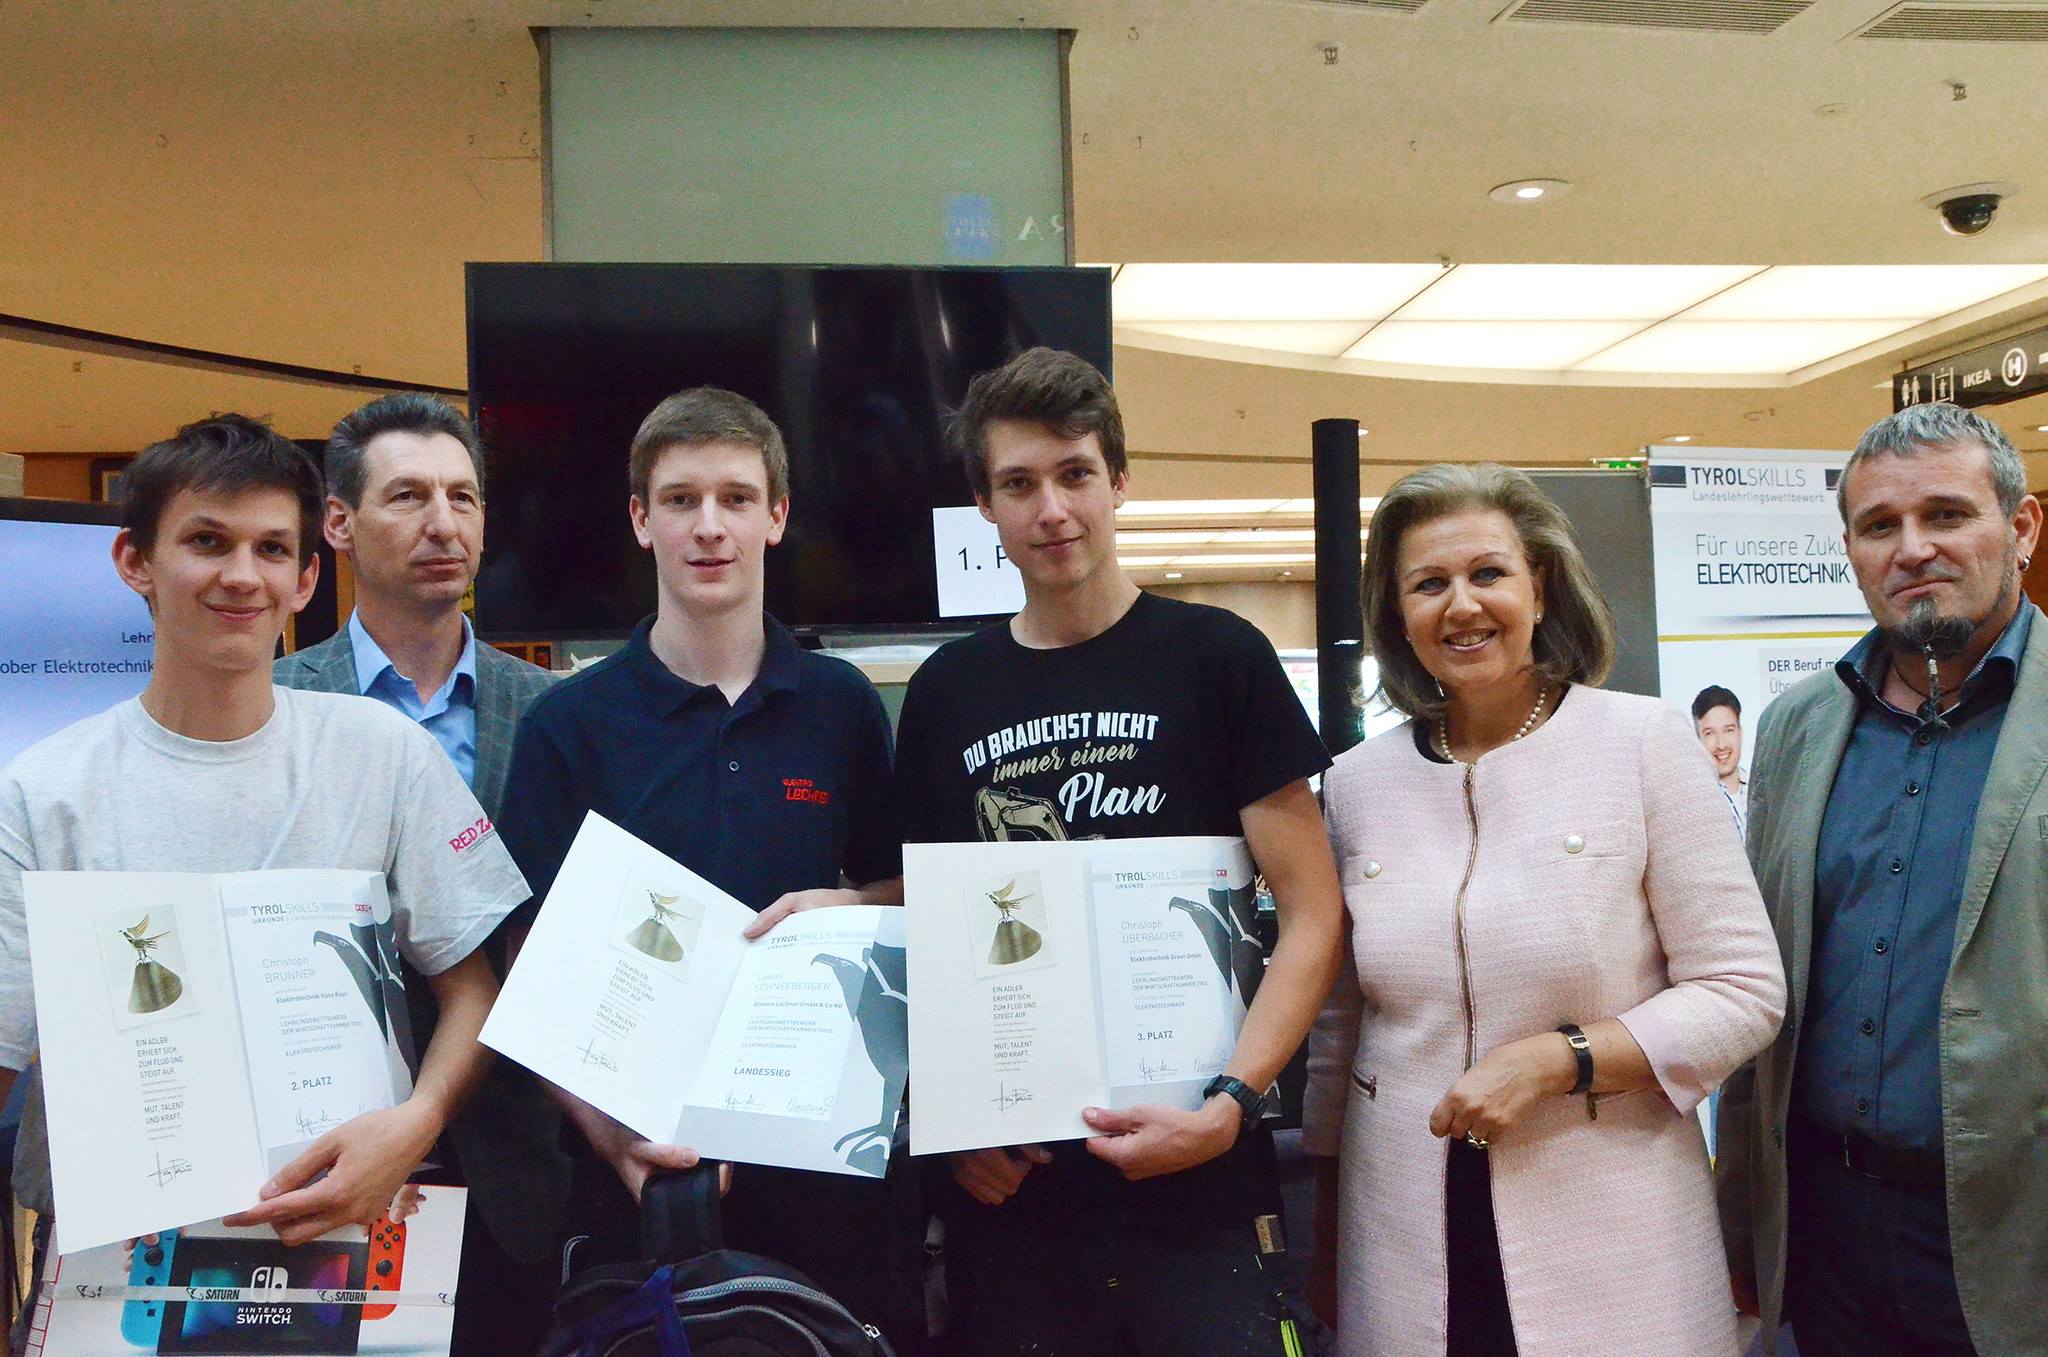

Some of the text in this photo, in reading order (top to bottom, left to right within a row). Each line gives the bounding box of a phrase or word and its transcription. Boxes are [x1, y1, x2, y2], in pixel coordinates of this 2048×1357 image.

[1962, 369, 1992, 388] IKEA
[1691, 467, 1806, 487] TYROLSKILLS
[1693, 491, 1825, 504] Landeslehrlingswettbewerb
[1696, 534, 1728, 556] Für
[1735, 540, 1798, 556] unsere
[958, 547, 981, 570] 1.
[1698, 563, 1850, 584] ELEKTROTECHNIK
[44, 660, 154, 674] Elektrotechnik
[1768, 660, 1790, 672] DER
[1794, 658, 1822, 671] Beruf
[963, 712, 1160, 775] DU BRAUCHST NICHT
[992, 741, 1139, 783] immer einen
[1058, 772, 1166, 822] Plan
[449, 826, 478, 852] RED
[1115, 870, 1178, 882] TYROLSKILLS
[251, 902, 319, 916] TYROLSKILLS
[1121, 920, 1163, 930] Christoph
[262, 956, 308, 968] Christoph
[265, 969, 316, 983] BRUNNER
[629, 966, 648, 980] ADLER
[596, 1012, 610, 1022] UND
[615, 1013, 637, 1029] TALENT
[148, 1036, 168, 1046] ADLER
[1137, 1030, 1173, 1041] 3. PLATZ
[138, 1046, 177, 1057] ERHEBT SICH
[139, 1059, 152, 1068] ZUM
[154, 1058, 170, 1066] FLUG
[140, 1070, 162, 1078] STEIGT
[734, 1068, 791, 1077] LANDESSIEG
[292, 1076, 332, 1090] 2. PLATZ
[161, 1101, 184, 1111] TALENT
[146, 1116, 160, 1124] UND
[205, 1289, 367, 1302] SATURN SATURN
